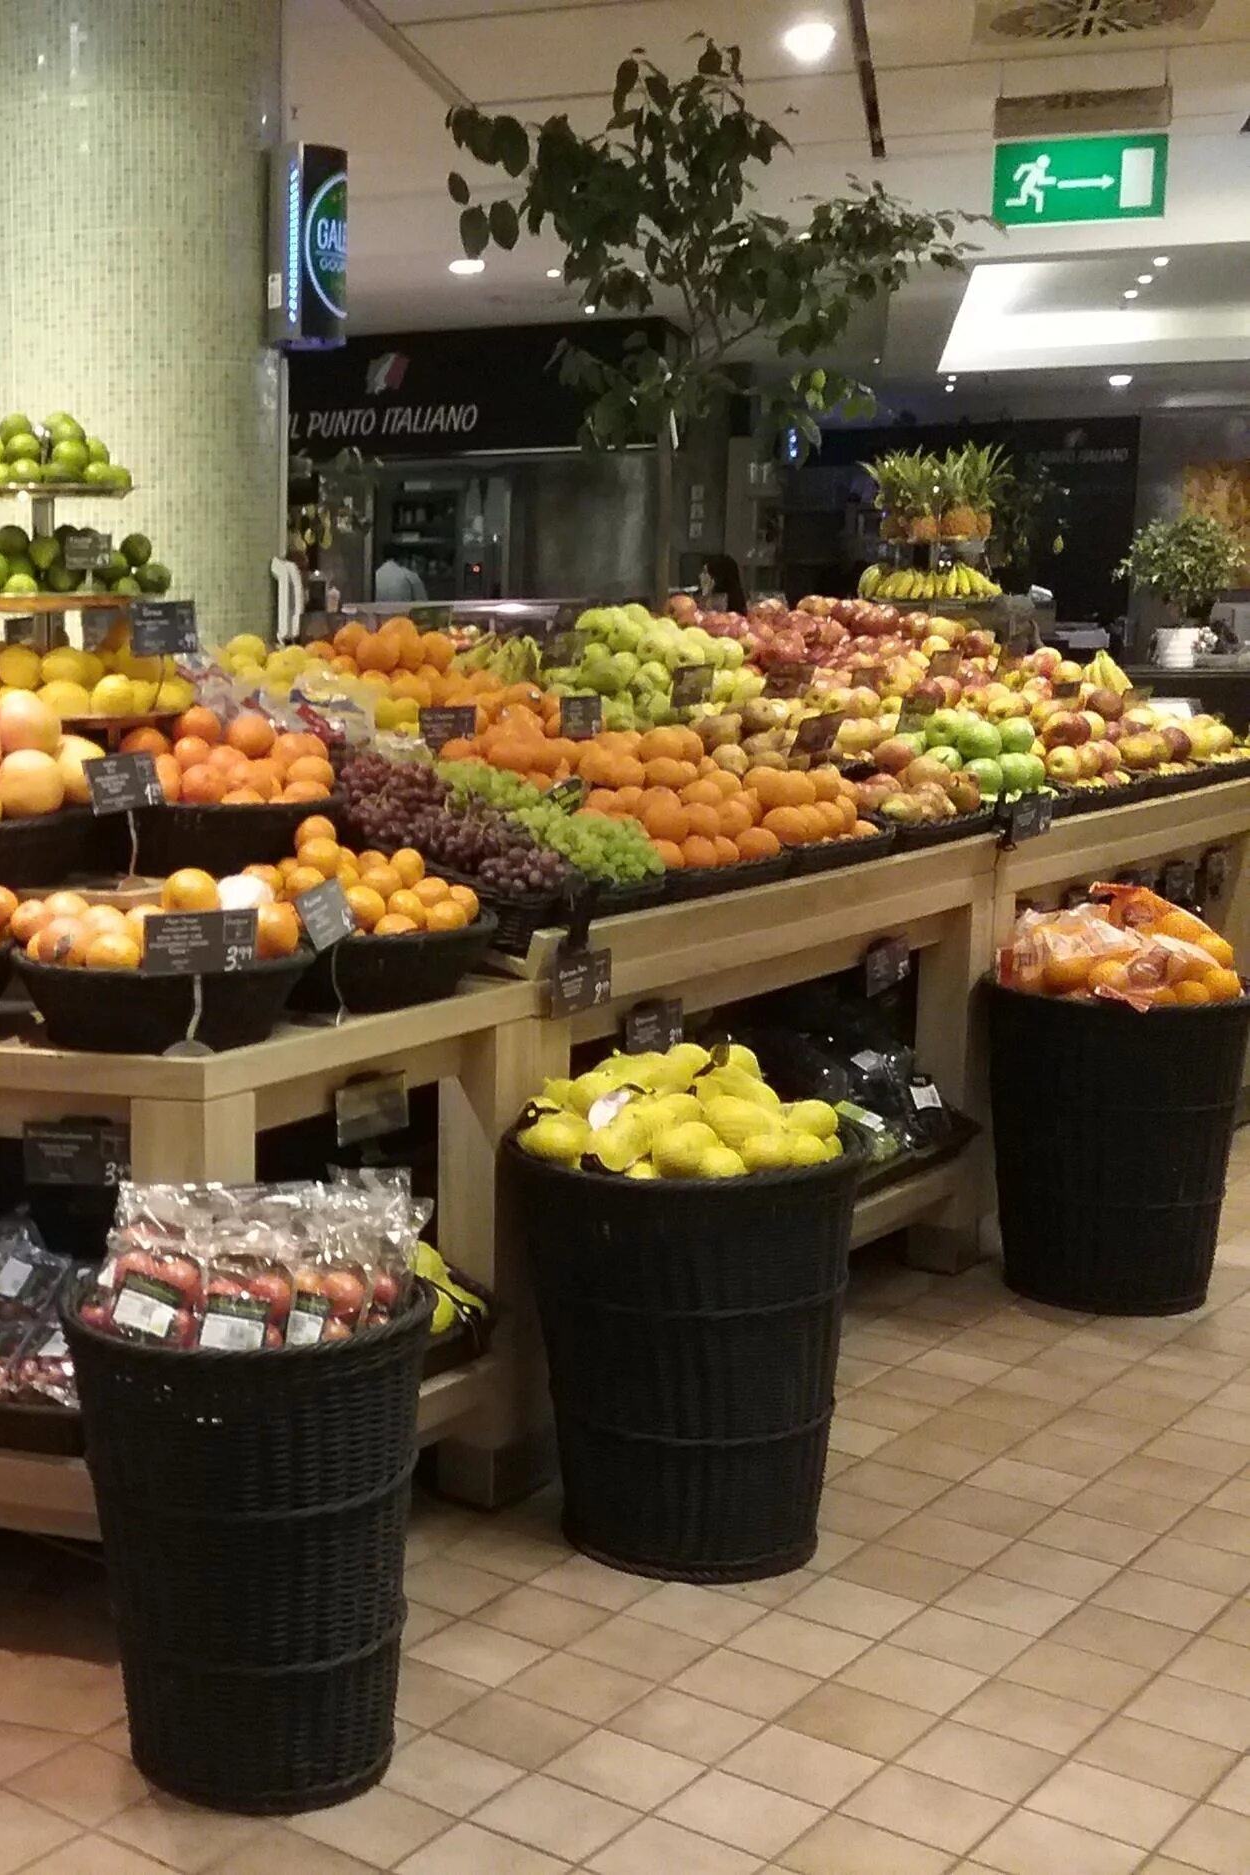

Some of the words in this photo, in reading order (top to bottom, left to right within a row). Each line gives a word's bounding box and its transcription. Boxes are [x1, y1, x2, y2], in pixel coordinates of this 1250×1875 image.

[307, 407, 376, 438] PUNTO
[381, 404, 479, 435] ITALIANO
[224, 945, 253, 972] 3.99
